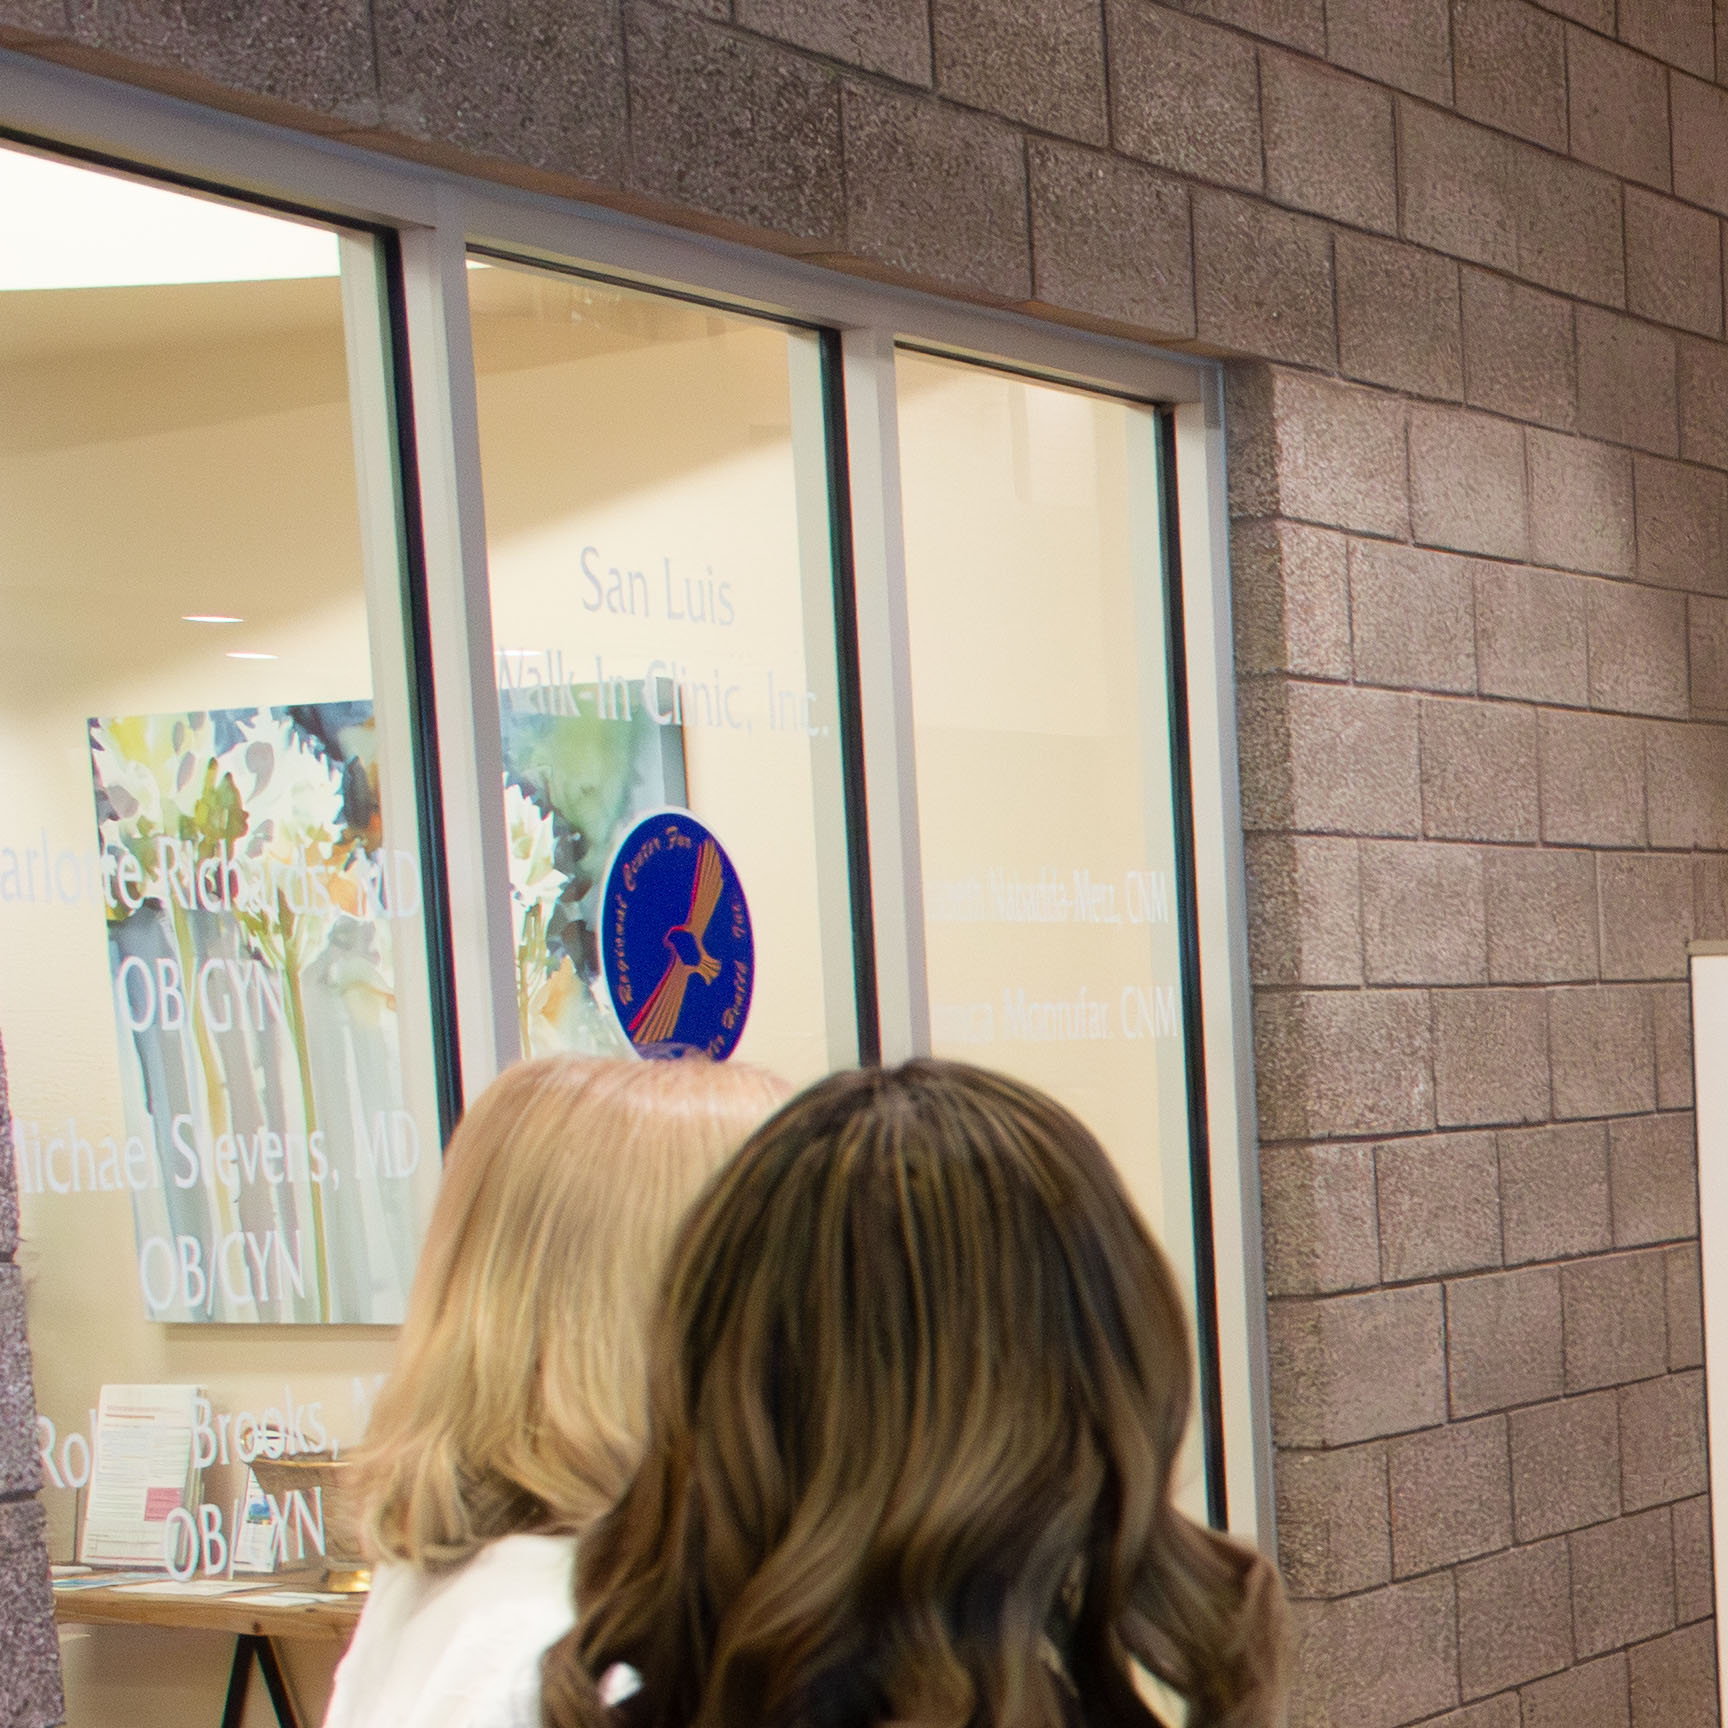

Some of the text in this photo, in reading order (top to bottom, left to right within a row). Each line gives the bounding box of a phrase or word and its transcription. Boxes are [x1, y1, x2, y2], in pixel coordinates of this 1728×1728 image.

[580, 545, 736, 628] San Luis
[767, 670, 830, 737] Inc.
[116, 955, 284, 1034] OB/GYN
[1120, 985, 1179, 1039] CNM
[353, 1110, 421, 1179] MD
[140, 1230, 306, 1317] OB/GYN
[190, 1385, 340, 1469] Brooks,
[163, 1486, 327, 1582] OB/YN
